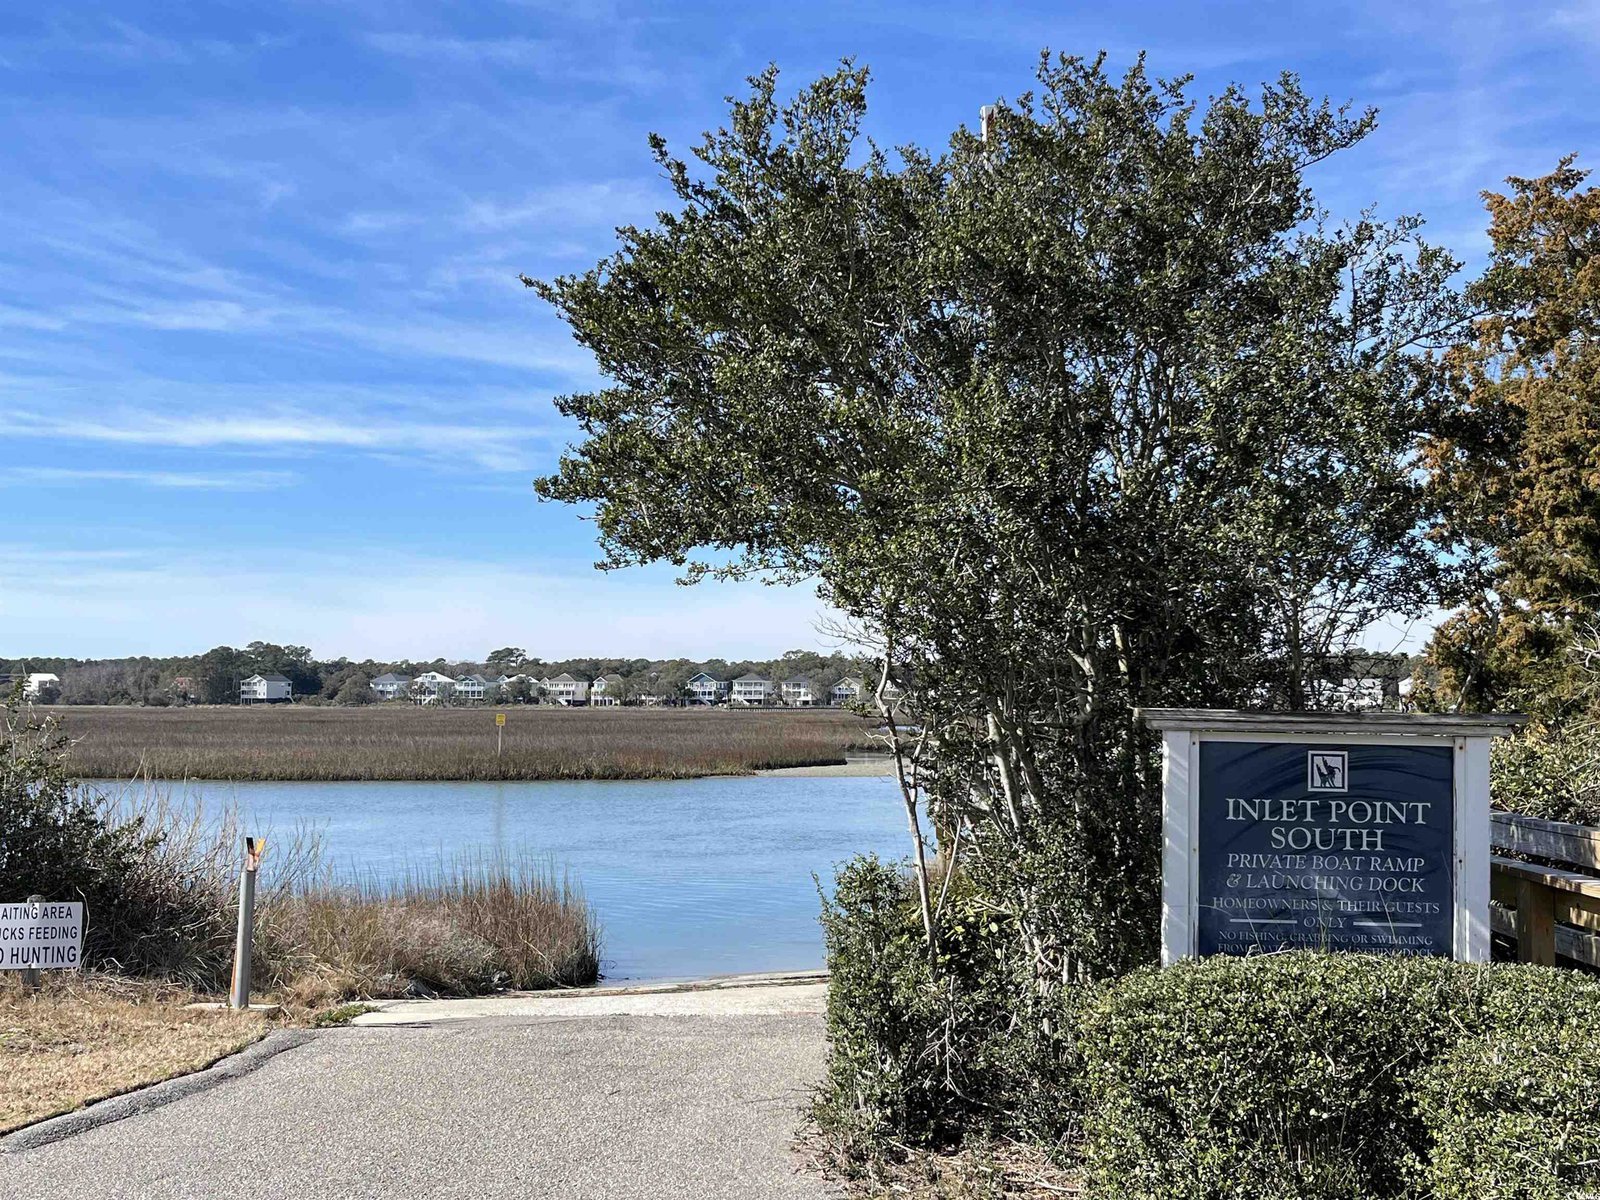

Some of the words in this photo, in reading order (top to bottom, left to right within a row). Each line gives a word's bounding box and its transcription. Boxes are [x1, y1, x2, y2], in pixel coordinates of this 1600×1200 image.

[1225, 798, 1320, 822] INLET
[1328, 800, 1431, 825] POINT
[1270, 827, 1384, 851] SOUTH
[1227, 853, 1307, 869] PRIVATE
[1312, 855, 1365, 871] BOAT
[1369, 857, 1425, 873] RAMP
[1226, 873, 1242, 888] &
[1246, 874, 1363, 891] LAUNCHING
[1369, 876, 1425, 893] DOCK
[41, 906, 73, 919] AREA
[1212, 897, 1318, 911] HOMEOWNERS
[1337, 900, 1381, 912] THEIR
[1384, 901, 1440, 914] GUESTS
[1303, 915, 1347, 929] ONLY
[28, 926, 78, 940] FEEDING
[1219, 930, 1237, 941] NO
[1351, 934, 1368, 944] OR
[1371, 935, 1433, 945] SWIMMING
[10, 945, 77, 964] HUNTING
